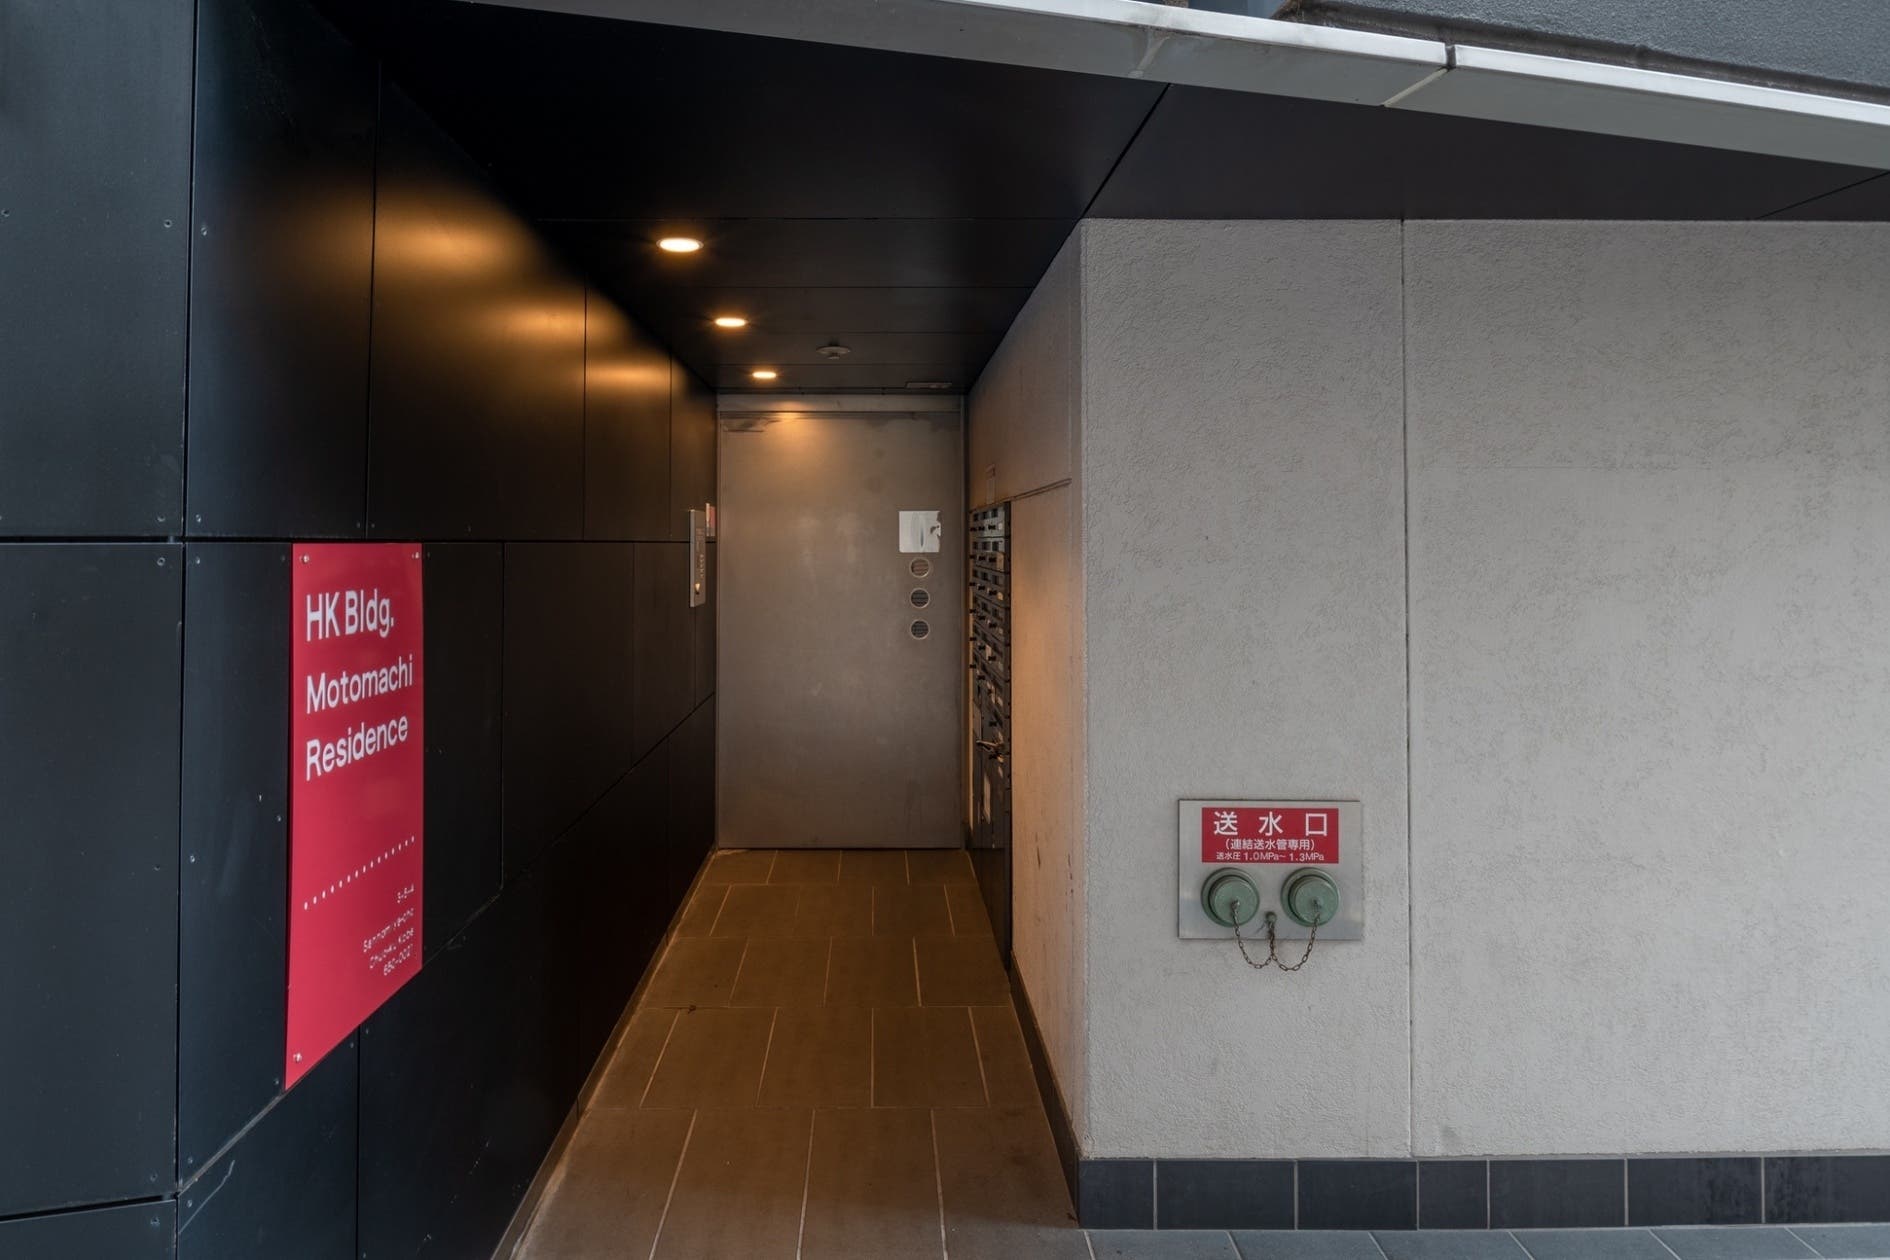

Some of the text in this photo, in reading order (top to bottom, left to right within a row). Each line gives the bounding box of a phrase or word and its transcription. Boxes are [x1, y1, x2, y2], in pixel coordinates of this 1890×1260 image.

[306, 588, 395, 642] HK Bldg.
[306, 653, 414, 715] Motomachi
[305, 714, 409, 782] Residence
[1213, 811, 1328, 837] 送水口
